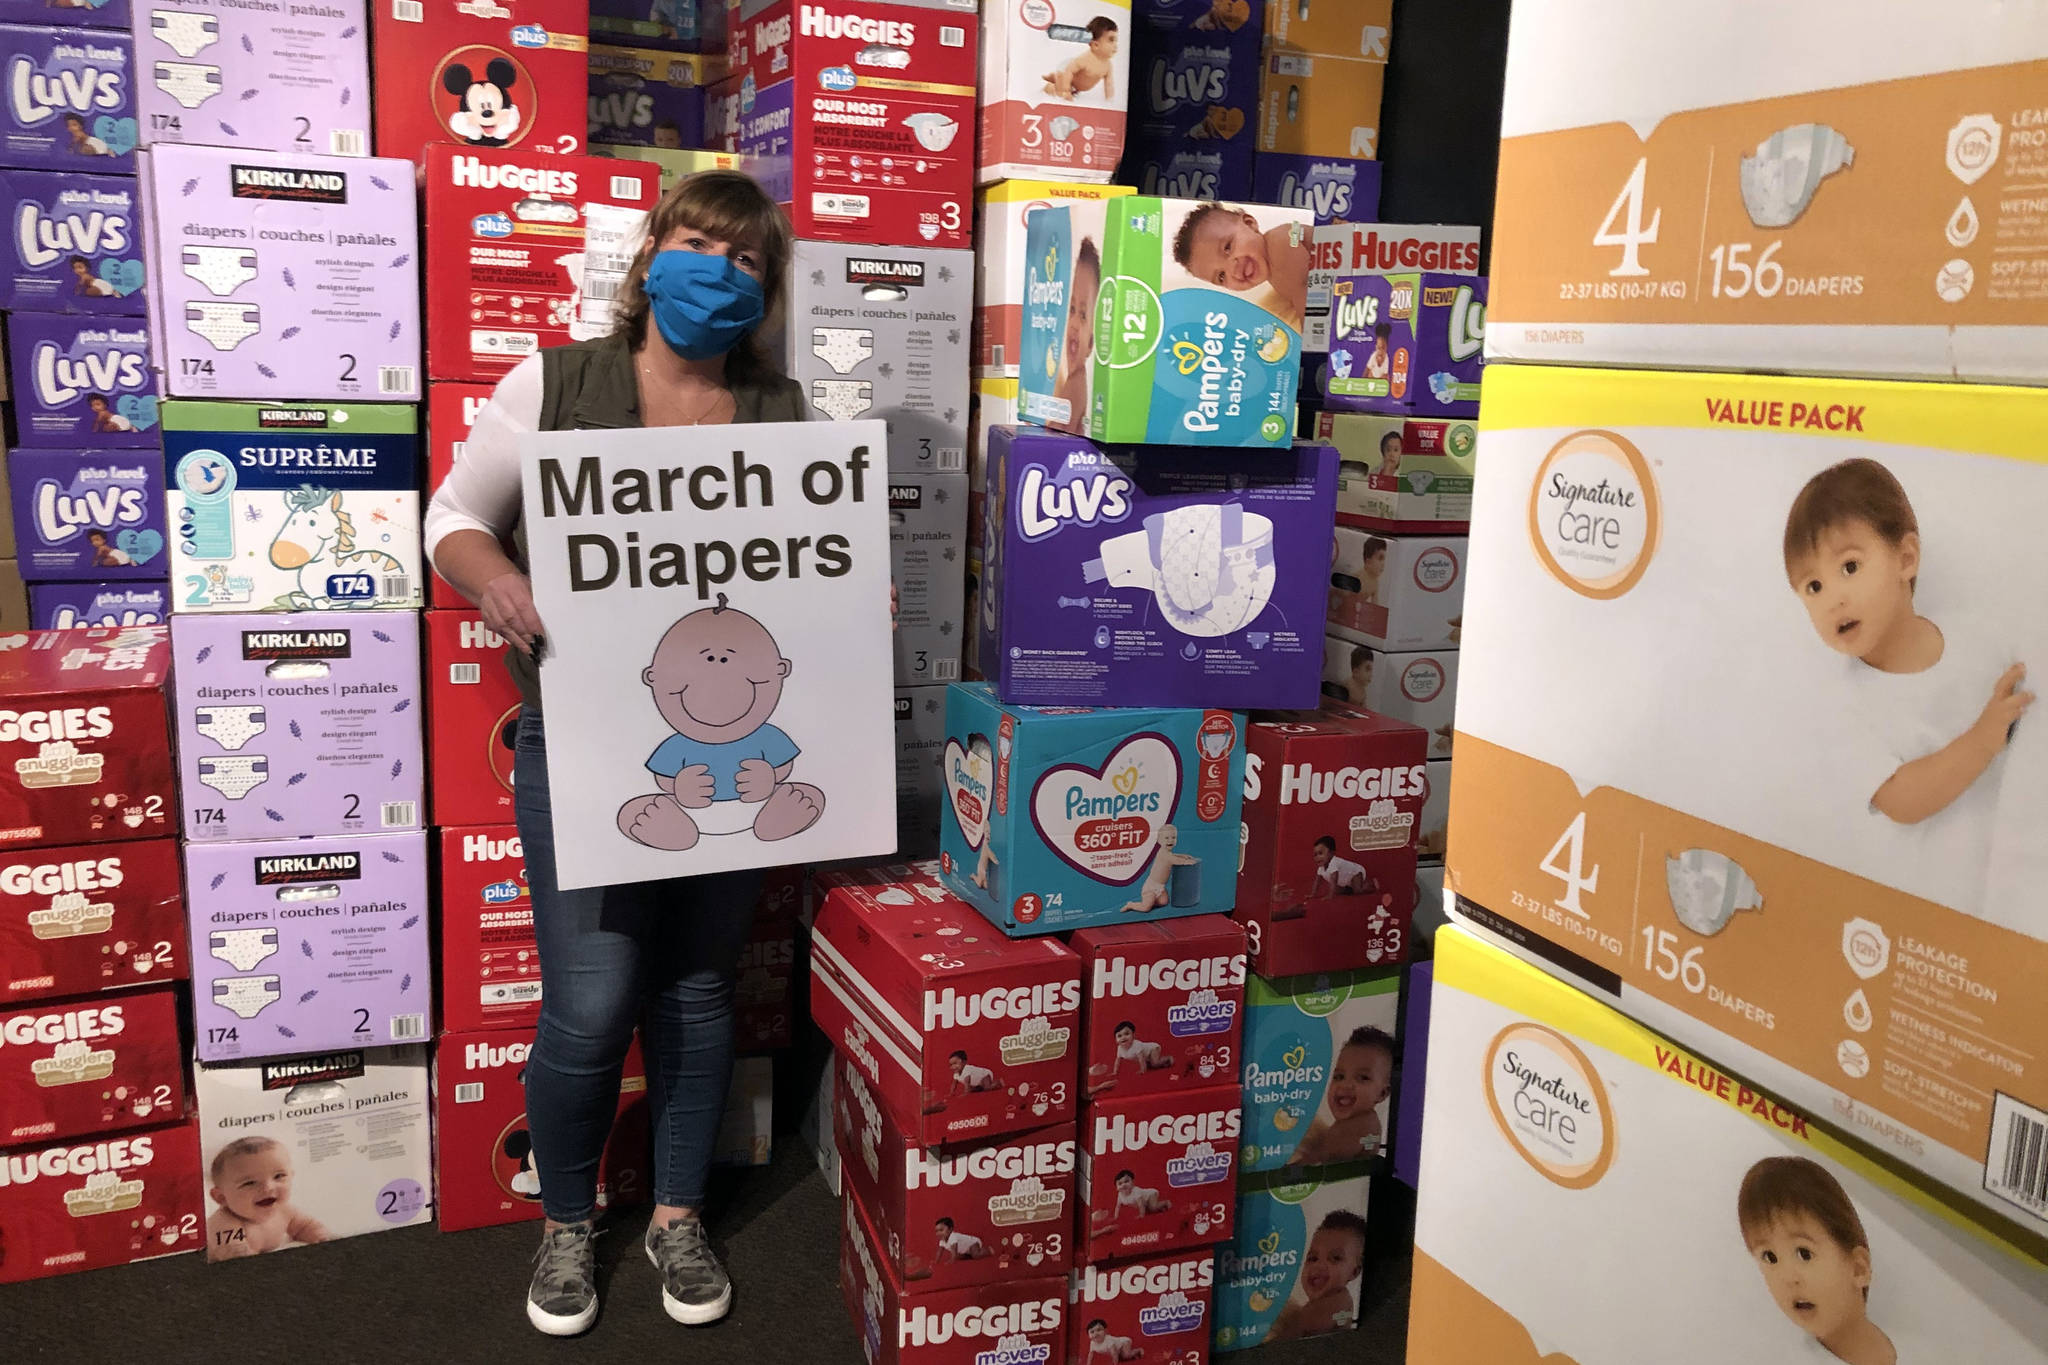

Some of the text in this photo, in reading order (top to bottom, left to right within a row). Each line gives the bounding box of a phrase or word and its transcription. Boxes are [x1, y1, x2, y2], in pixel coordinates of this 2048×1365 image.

[513, 26, 547, 46] plus
[800, 5, 915, 46] HUGGIES
[821, 64, 855, 89] plus
[813, 98, 844, 112] OUR
[150, 114, 182, 131] 174
[1264, 90, 1280, 149] diapers
[814, 125, 911, 142] NOTRE COUCHE LA
[1019, 115, 1043, 147] 3
[814, 135, 915, 152] PLUS ABSORBANTE
[1049, 141, 1074, 157] 180
[236, 168, 343, 192] KIRKLAND
[452, 155, 578, 195] HUGGIES
[1049, 189, 1101, 200] VALUE PACK
[474, 214, 513, 234] plus
[919, 212, 940, 224] 198
[941, 201, 961, 230] 3
[1592, 156, 1662, 277] 4
[183, 223, 398, 247] diapers couches pañales
[1352, 231, 1480, 271] HUGGIES
[315, 258, 374, 269] stylish designs
[850, 261, 922, 277] KIRKLAND
[1710, 240, 1863, 299] 156 DIAPERS
[316, 283, 343, 293] design
[1028, 267, 1064, 311] Pampers
[1390, 289, 1413, 309] 20X
[1425, 290, 1453, 304] NEW!
[1559, 281, 1687, 300] 22-37 LBS (10-17 KG)
[811, 305, 957, 322] diapers couches pañales
[1336, 294, 1379, 341] Luvs
[1122, 313, 1147, 344] 12
[1525, 330, 1585, 344] 156 DIAPERS
[181, 359, 215, 376] 174
[1183, 310, 1230, 433] Pampers
[1224, 328, 1250, 417] baby-dry
[1268, 391, 1281, 413] 144
[262, 410, 326, 422] KIRKLAND
[1706, 397, 1866, 433] VALUE PACK
[239, 444, 377, 467] SUPRÊME
[918, 438, 931, 460] 3
[539, 446, 870, 518] March of
[1371, 475, 1378, 488] 3
[1548, 472, 1637, 511] Signature
[1020, 468, 1131, 537] Luvs
[912, 531, 952, 542] pañales
[566, 531, 853, 601] Diapers
[1421, 560, 1451, 570] Signature
[332, 578, 370, 594] 174
[247, 633, 347, 648] KIRKLAND
[197, 681, 398, 701] diapers couches pañales
[18, 755, 101, 772] snugglers
[954, 757, 987, 801] Pampers
[1280, 763, 1426, 805] HUGGIES
[343, 794, 361, 819] 2
[1066, 785, 1160, 821] Pampers
[194, 808, 227, 824] 174
[1350, 812, 1413, 831] snugglers
[1095, 822, 1133, 833] cruisers
[1080, 829, 1144, 849] 360° FIT
[260, 855, 357, 874] KIRKLAND
[1538, 811, 1600, 920] 4
[0, 858, 123, 896] GGIES
[484, 880, 519, 903] plus
[1045, 893, 1063, 908] 74
[31, 904, 112, 924] snugglers
[210, 901, 407, 924] diapers couches pañales
[480, 910, 534, 921] OUR MOST
[1510, 890, 1540, 914] 22-37
[1541, 905, 1563, 926] LBS
[1563, 916, 1598, 942] (10-17
[1599, 932, 1623, 957] KG)
[1367, 938, 1384, 949] 136
[1897, 935, 1969, 973] LEAKAGE
[133, 952, 152, 962] 148
[1093, 954, 1247, 999] HUGGIES
[1641, 924, 1776, 1031] 156 DIAPERS
[1896, 952, 1998, 1005] PROTECTION
[924, 979, 1081, 1032] HUGGIES
[1168, 1000, 1235, 1022] movers
[353, 1008, 371, 1033] 2
[207, 1027, 239, 1043] 174
[1001, 1028, 1070, 1050] snugglers
[1889, 1008, 2024, 1078] WETNESS INDICATOR
[34, 1051, 114, 1072] snugglers
[1200, 1055, 1214, 1065] 84
[1245, 1062, 1323, 1091] Pampers
[1502, 1050, 1592, 1115] Signature
[133, 1096, 152, 1106] 148
[1033, 1092, 1048, 1103] 76
[1254, 1088, 1312, 1105] baby-dry
[1654, 1044, 1812, 1141] VALUE PACK
[218, 1089, 409, 1129] diapers couches pañales
[1094, 1107, 1242, 1156] HUGGIES
[1857, 1108, 1925, 1157] DIAPERS
[1262, 1144, 1281, 1157] 144
[906, 1140, 1076, 1190] HUGGIES
[1167, 1152, 1231, 1174] movers
[67, 1181, 143, 1201] snugglers
[991, 1189, 1064, 1209] snugglers
[215, 1227, 245, 1246] 174
[1028, 1243, 1043, 1254] 76
[1221, 1248, 1297, 1275] Pampers
[1076, 1258, 1214, 1302] HUGGIES
[1230, 1271, 1286, 1289] baby-dry
[1140, 1301, 1204, 1320] movers
[898, 1298, 1061, 1349] HUGGIES
